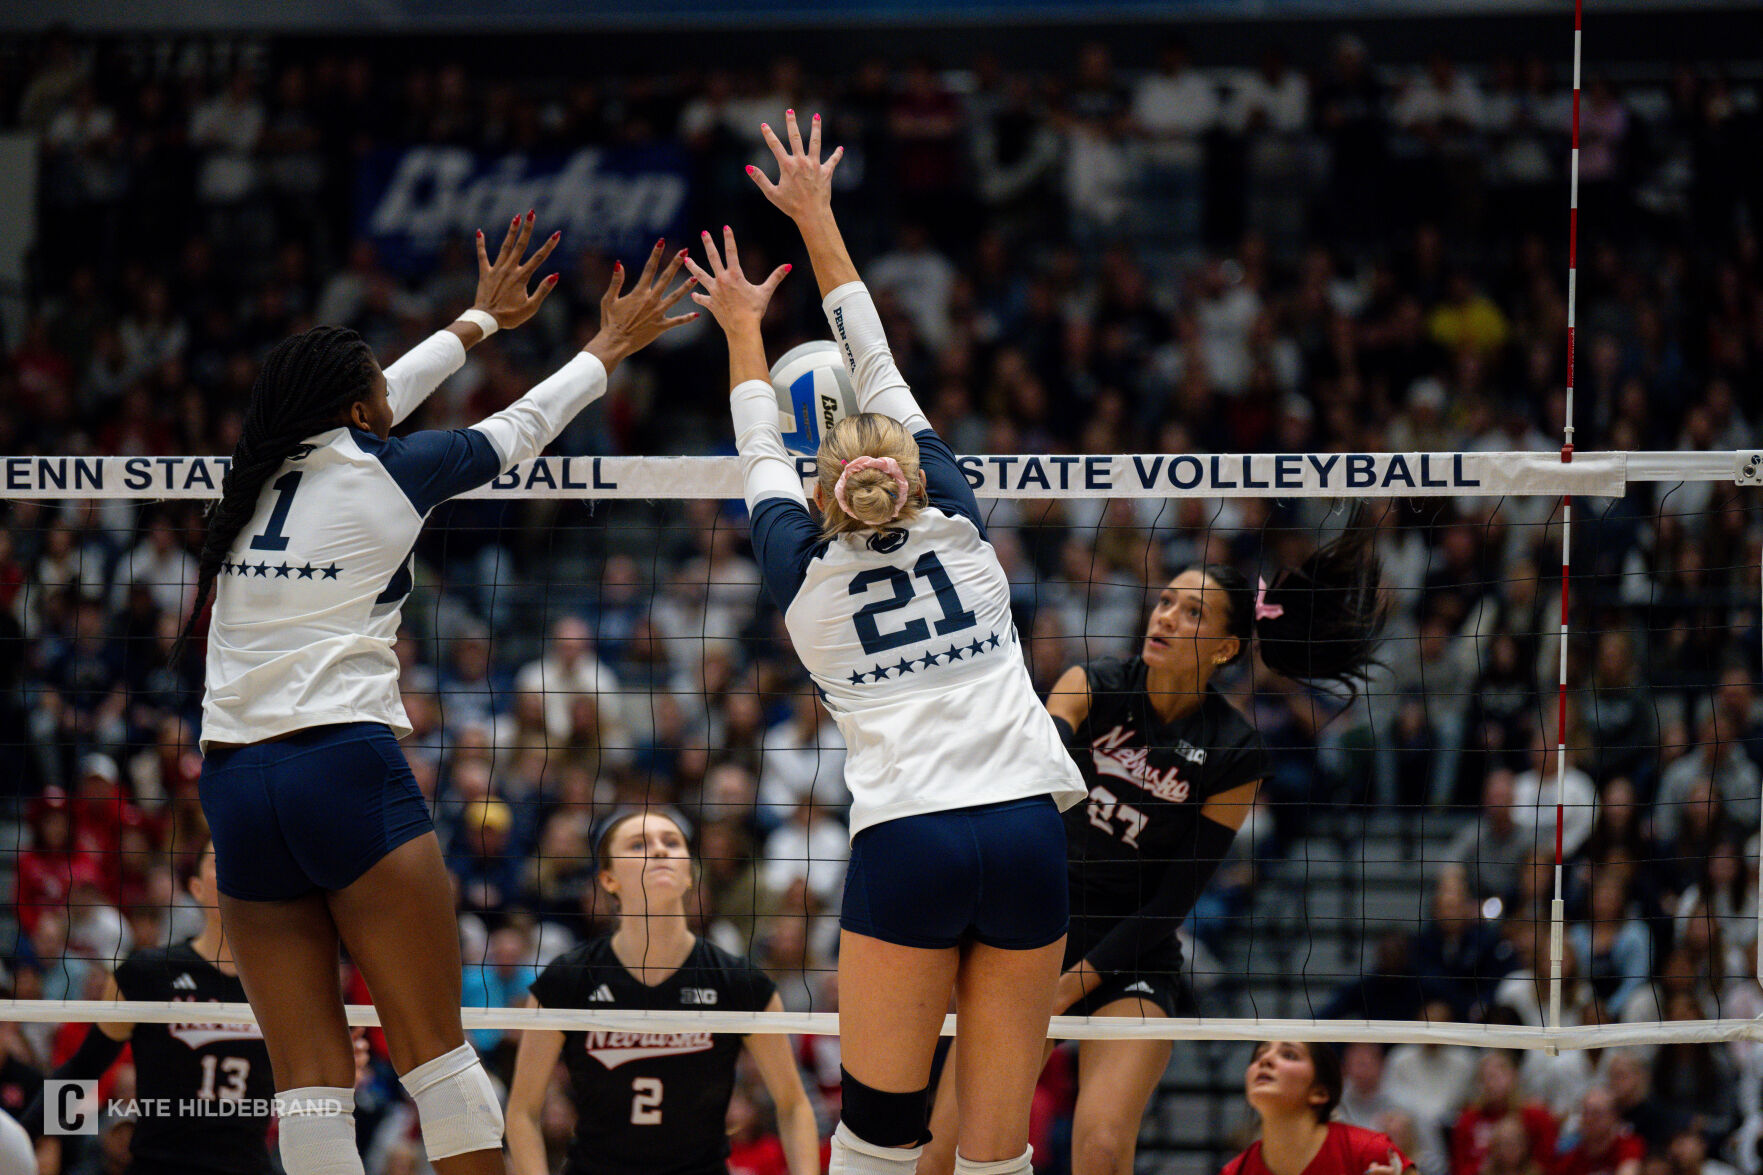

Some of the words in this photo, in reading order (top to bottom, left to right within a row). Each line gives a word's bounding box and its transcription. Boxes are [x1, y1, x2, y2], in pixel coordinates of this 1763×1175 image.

[844, 342, 856, 374] STA
[5, 457, 104, 490] ENN
[123, 457, 232, 491] STAT
[957, 455, 1113, 490] STATE
[1132, 453, 1481, 490] VOLLEYBALL
[250, 470, 303, 551] 1
[848, 550, 977, 656] 21
[1091, 724, 1190, 803] Nebraska
[1086, 785, 1149, 849] 27
[196, 1054, 251, 1102] 13
[630, 1076, 664, 1125] 2
